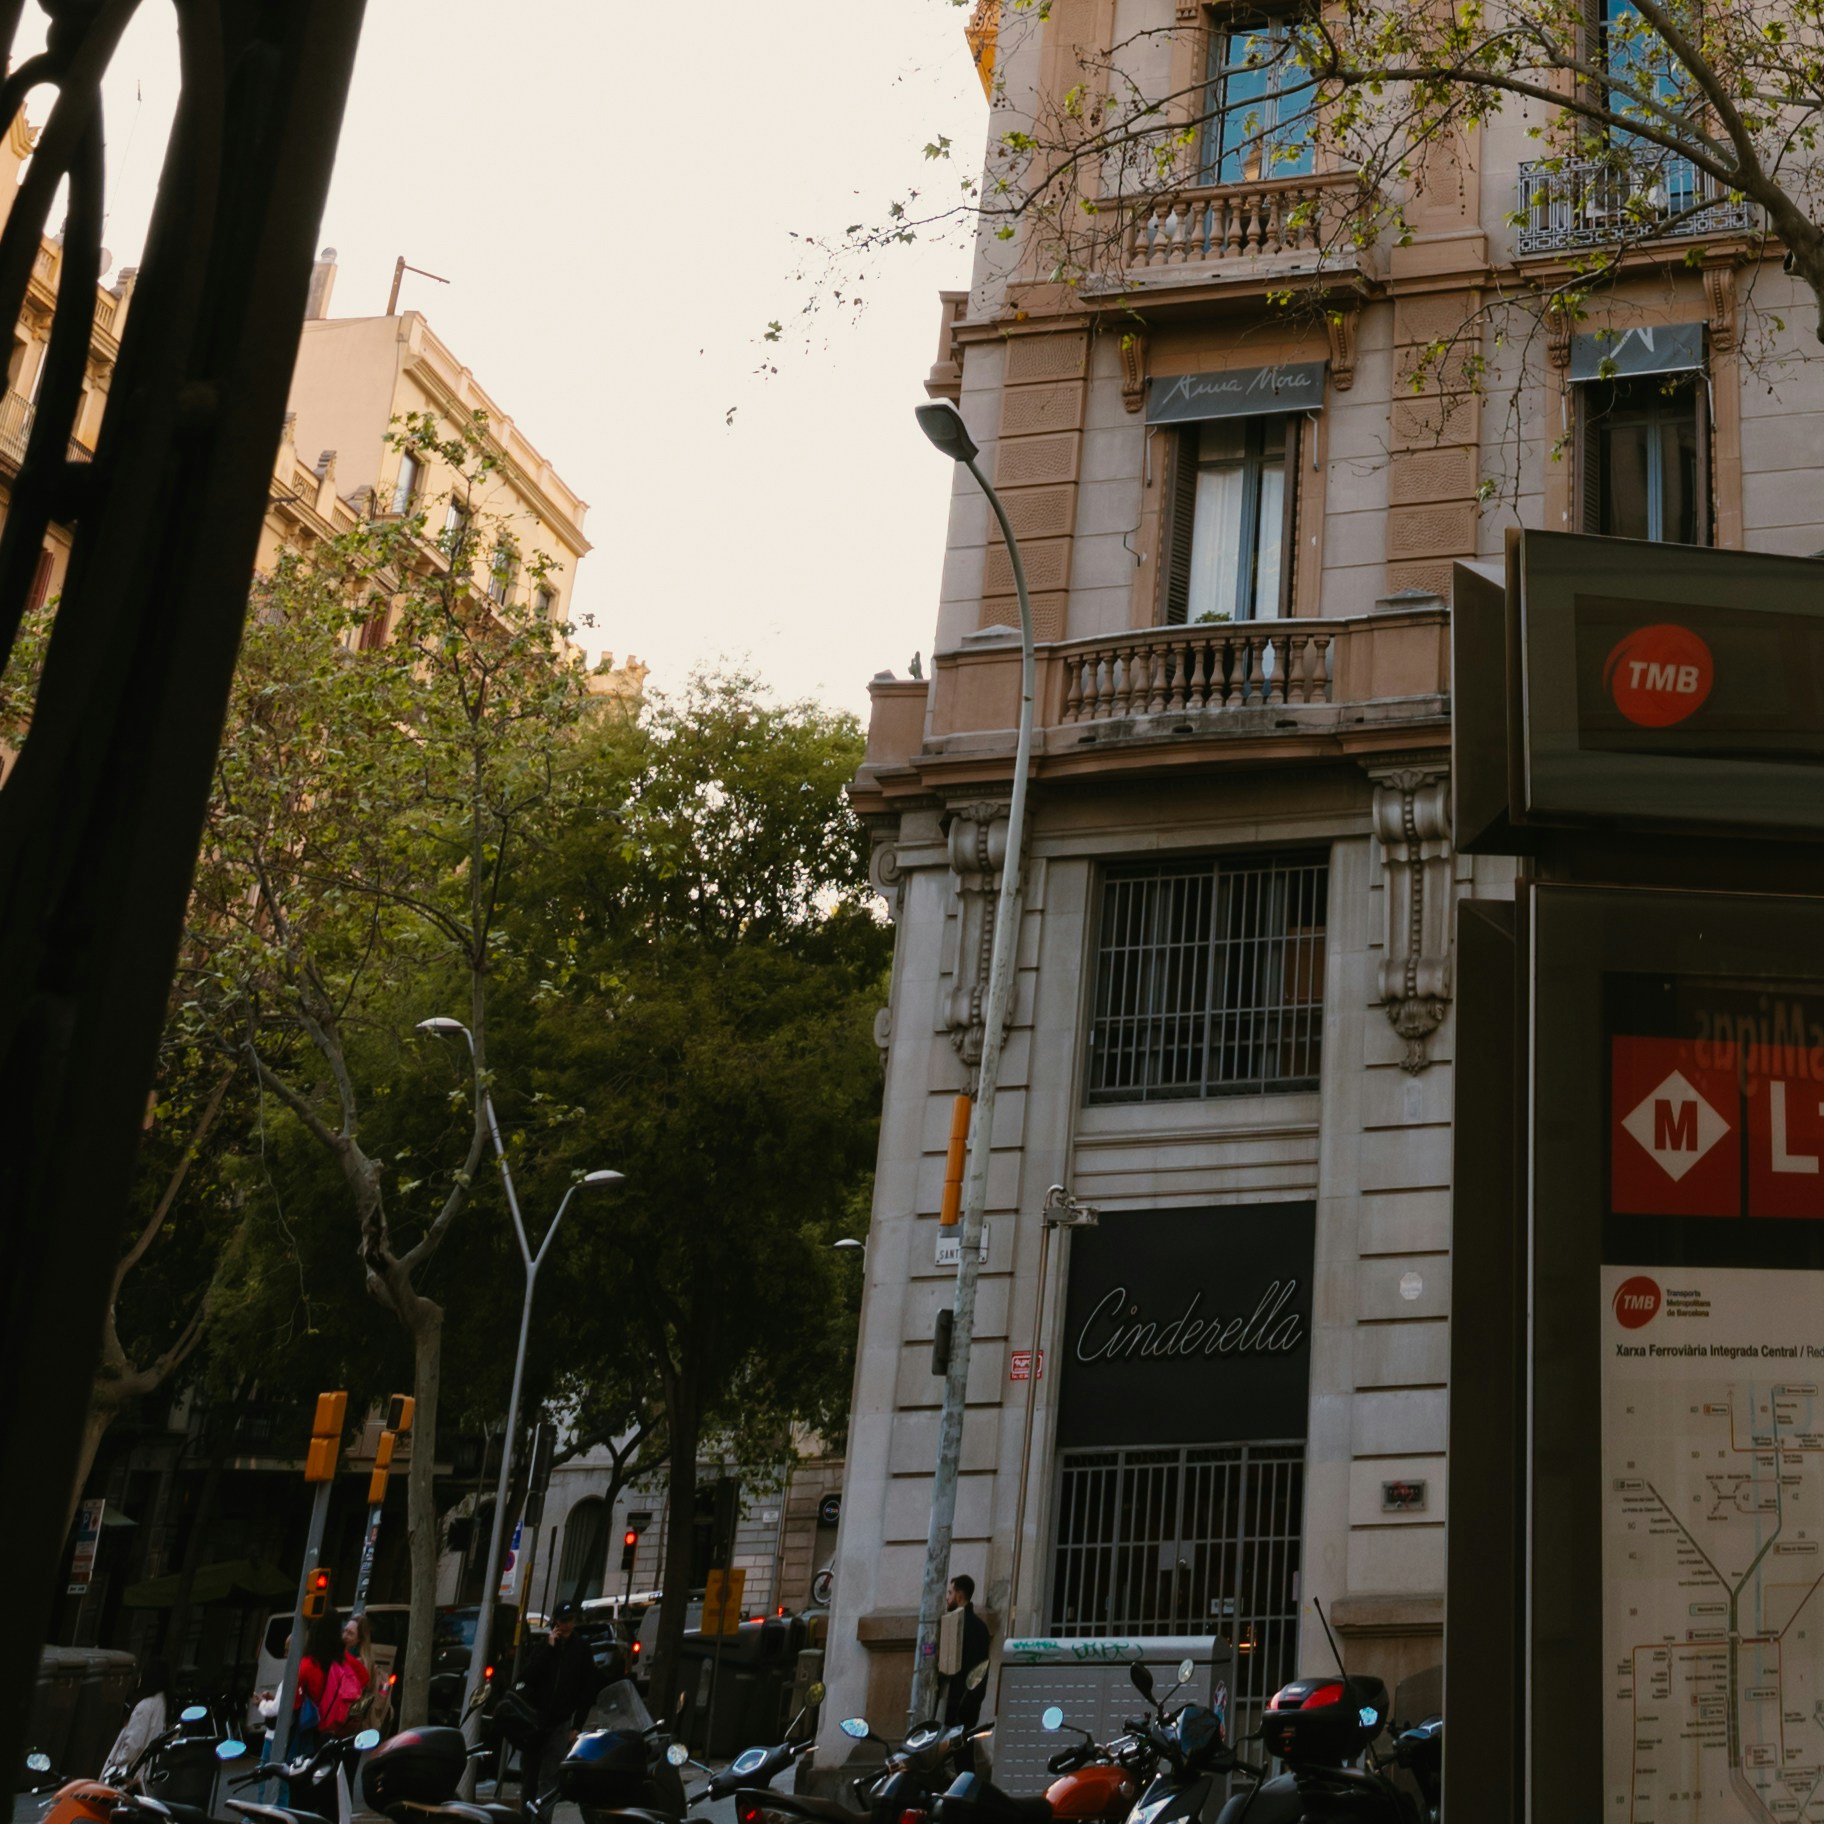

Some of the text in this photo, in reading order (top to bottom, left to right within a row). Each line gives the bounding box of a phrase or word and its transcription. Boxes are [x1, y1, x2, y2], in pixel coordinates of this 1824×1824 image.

[1163, 366, 1311, 404] Anna Mora
[1628, 659, 1698, 696] TMB
[1654, 1101, 1698, 1152] M
[1623, 1294, 1655, 1310] TMB
[1666, 1288, 1701, 1298] Transports
[1075, 1278, 1306, 1363] Cinderella
[1676, 1309, 1709, 1318] Barcelona
[1616, 1344, 1646, 1357] Xarxa
[1649, 1344, 1707, 1357] Ferroviària
[1710, 1345, 1758, 1359] Integrada
[1761, 1346, 1797, 1358] Central
